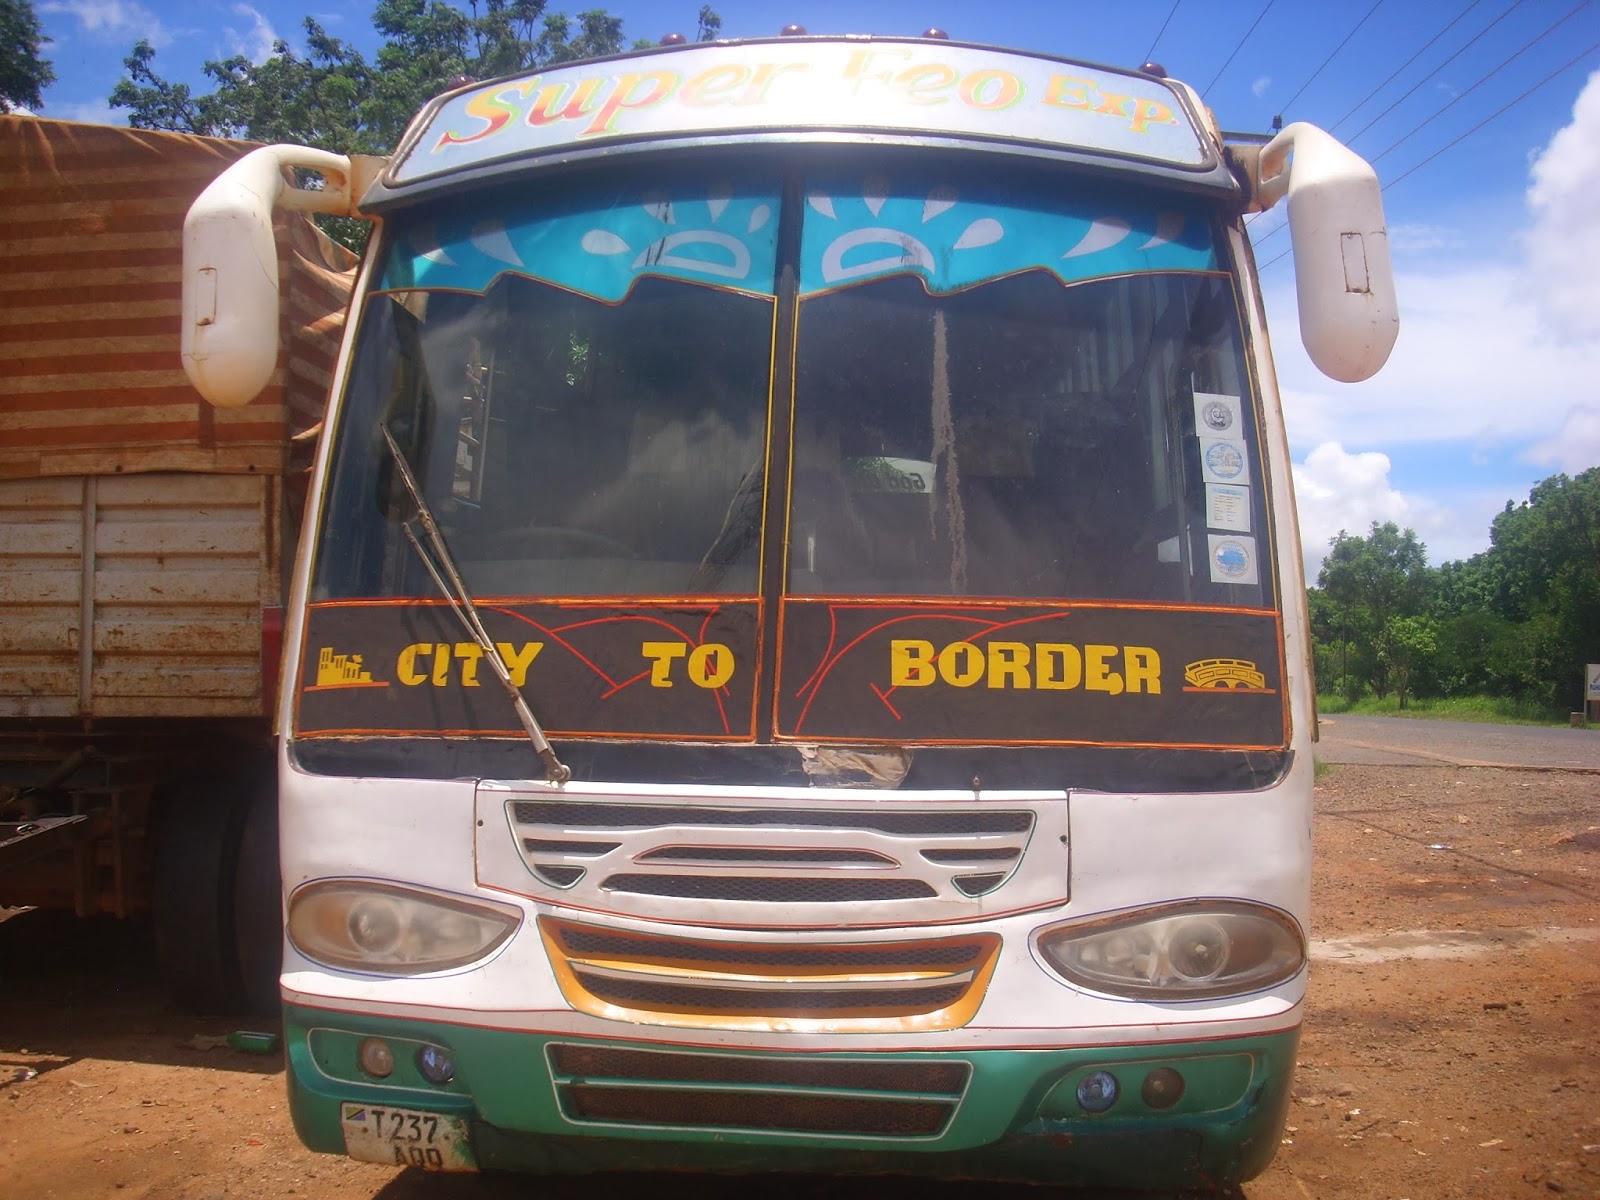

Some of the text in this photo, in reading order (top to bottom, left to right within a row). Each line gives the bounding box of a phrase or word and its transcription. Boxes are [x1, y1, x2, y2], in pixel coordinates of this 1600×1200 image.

[431, 61, 813, 152] Super
[397, 639, 1161, 696] CITY TO BORDER
